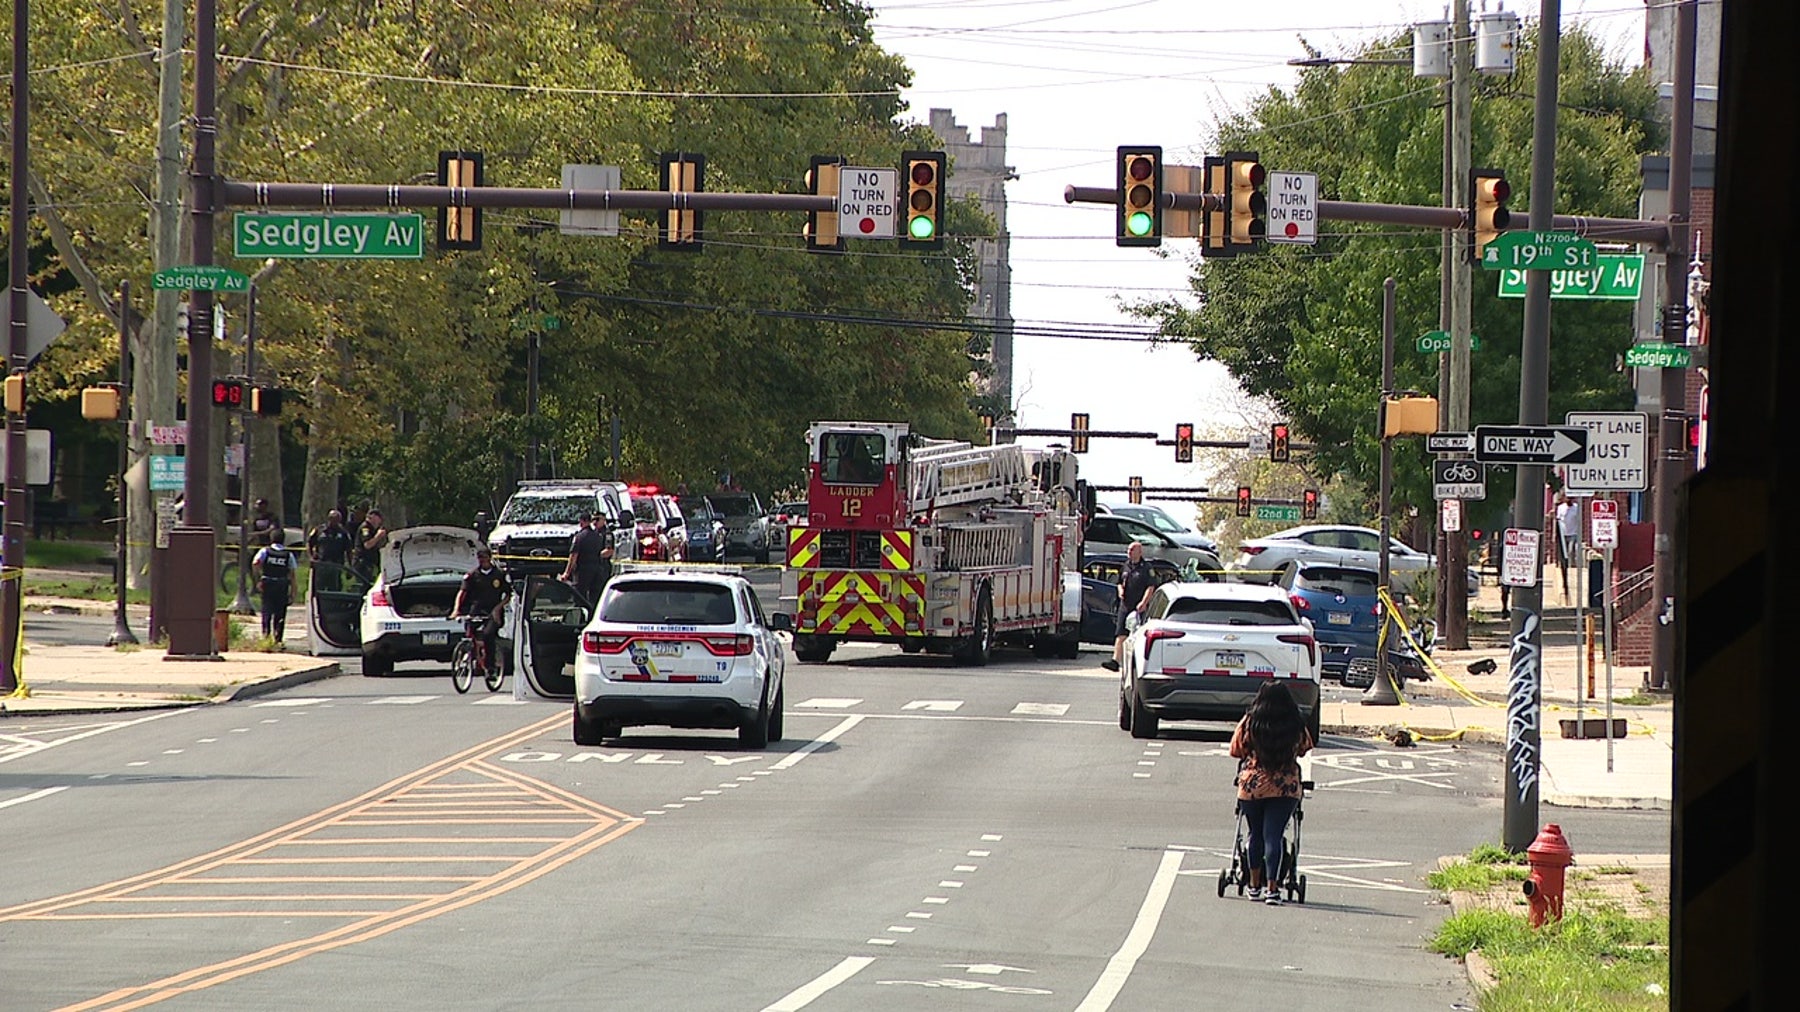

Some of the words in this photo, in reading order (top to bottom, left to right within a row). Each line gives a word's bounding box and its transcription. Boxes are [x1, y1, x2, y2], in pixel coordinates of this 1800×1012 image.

[857, 172, 879, 187] NO
[1283, 176, 1303, 191] NO
[851, 188, 885, 201] TURN
[1279, 193, 1308, 206] TURN
[841, 203, 861, 216] ON
[866, 204, 893, 216] RED
[1270, 207, 1287, 220] ON
[1291, 208, 1314, 222] RED
[243, 218, 370, 254] Sedgley
[384, 220, 414, 247] Av
[1535, 233, 1544, 244] N
[1546, 234, 1571, 244] 2700
[1512, 244, 1553, 266] 19th
[1564, 246, 1591, 267] St
[155, 273, 218, 290] Sedgley
[223, 275, 243, 288] Av
[1506, 263, 1606, 295] Sgley
[1612, 261, 1638, 288] Av
[1421, 337, 1451, 352] Opa
[1627, 349, 1673, 367] Sedgley
[1675, 352, 1689, 365] Av
[1608, 421, 1643, 434] LANE
[1432, 438, 1449, 447] ONE
[1452, 439, 1468, 448] WAY
[1487, 437, 1518, 452] ONE
[1523, 438, 1554, 453] WAY
[1571, 468, 1607, 481] TURN
[1612, 469, 1642, 481] LEFT
[829, 486, 875, 497] LADDER
[1438, 485, 1456, 496] BIKE
[1459, 485, 1482, 496] LANE
[841, 498, 862, 517] 12
[1258, 509, 1283, 519] 22nd
[1287, 510, 1297, 519] St
[499, 752, 764, 767] ONLY
